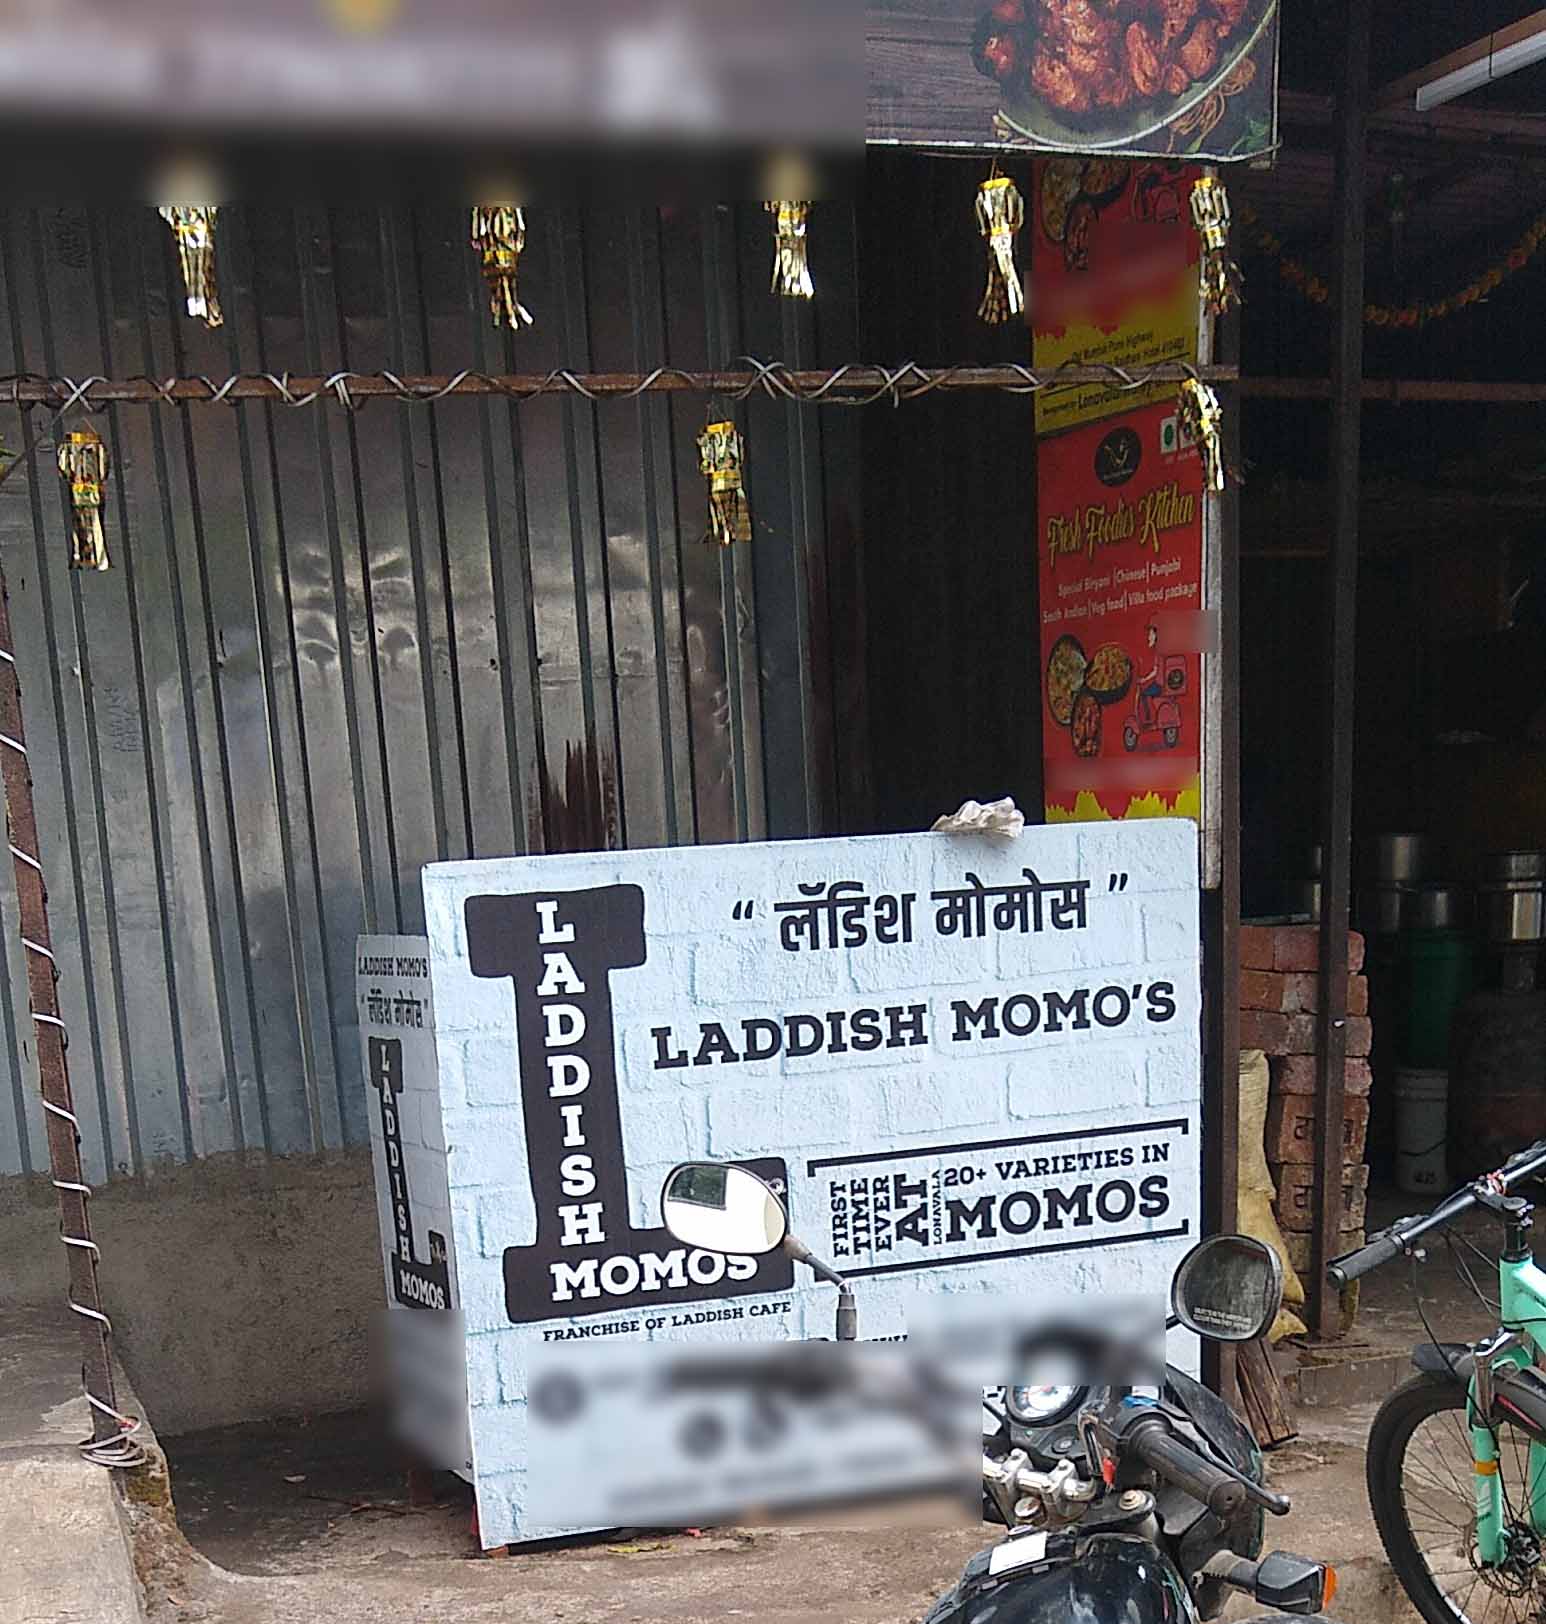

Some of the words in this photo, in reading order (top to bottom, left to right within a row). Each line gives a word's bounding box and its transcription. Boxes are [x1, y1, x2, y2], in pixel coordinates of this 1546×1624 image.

[1047, 508, 1082, 567] Fresh
[1085, 498, 1136, 559] Foodies
[1138, 481, 1196, 553] Kitchen
[1146, 587, 1164, 602] food
[1165, 581, 1198, 601] package
[773, 880, 918, 952] लॅडिश
[930, 868, 1091, 938] मोमोस
[358, 957, 394, 976] LADDISH
[650, 1003, 929, 1070] LADDISH
[950, 981, 1177, 1042] MOMO'S
[535, 900, 607, 1247] LADDISH
[379, 1043, 412, 1265] LADDISH
[943, 1165, 987, 1187] 20+
[995, 1147, 1135, 1181] VARIETIES
[1141, 1142, 1171, 1164] IN
[829, 1180, 850, 1258] FIRST
[850, 1177, 872, 1255] TIME
[872, 1175, 893, 1253] EVER
[893, 1173, 930, 1247] AT
[932, 1169, 943, 1245] LONAVALA
[945, 1174, 1171, 1243] MOMOS
[400, 1269, 446, 1310] MOMOS
[550, 1248, 759, 1302] MOMOS
[543, 1318, 641, 1342] FRANCHISE
[645, 1316, 667, 1330] OF
[671, 1306, 745, 1328] LADDISH
[749, 1301, 792, 1318] CAFE
